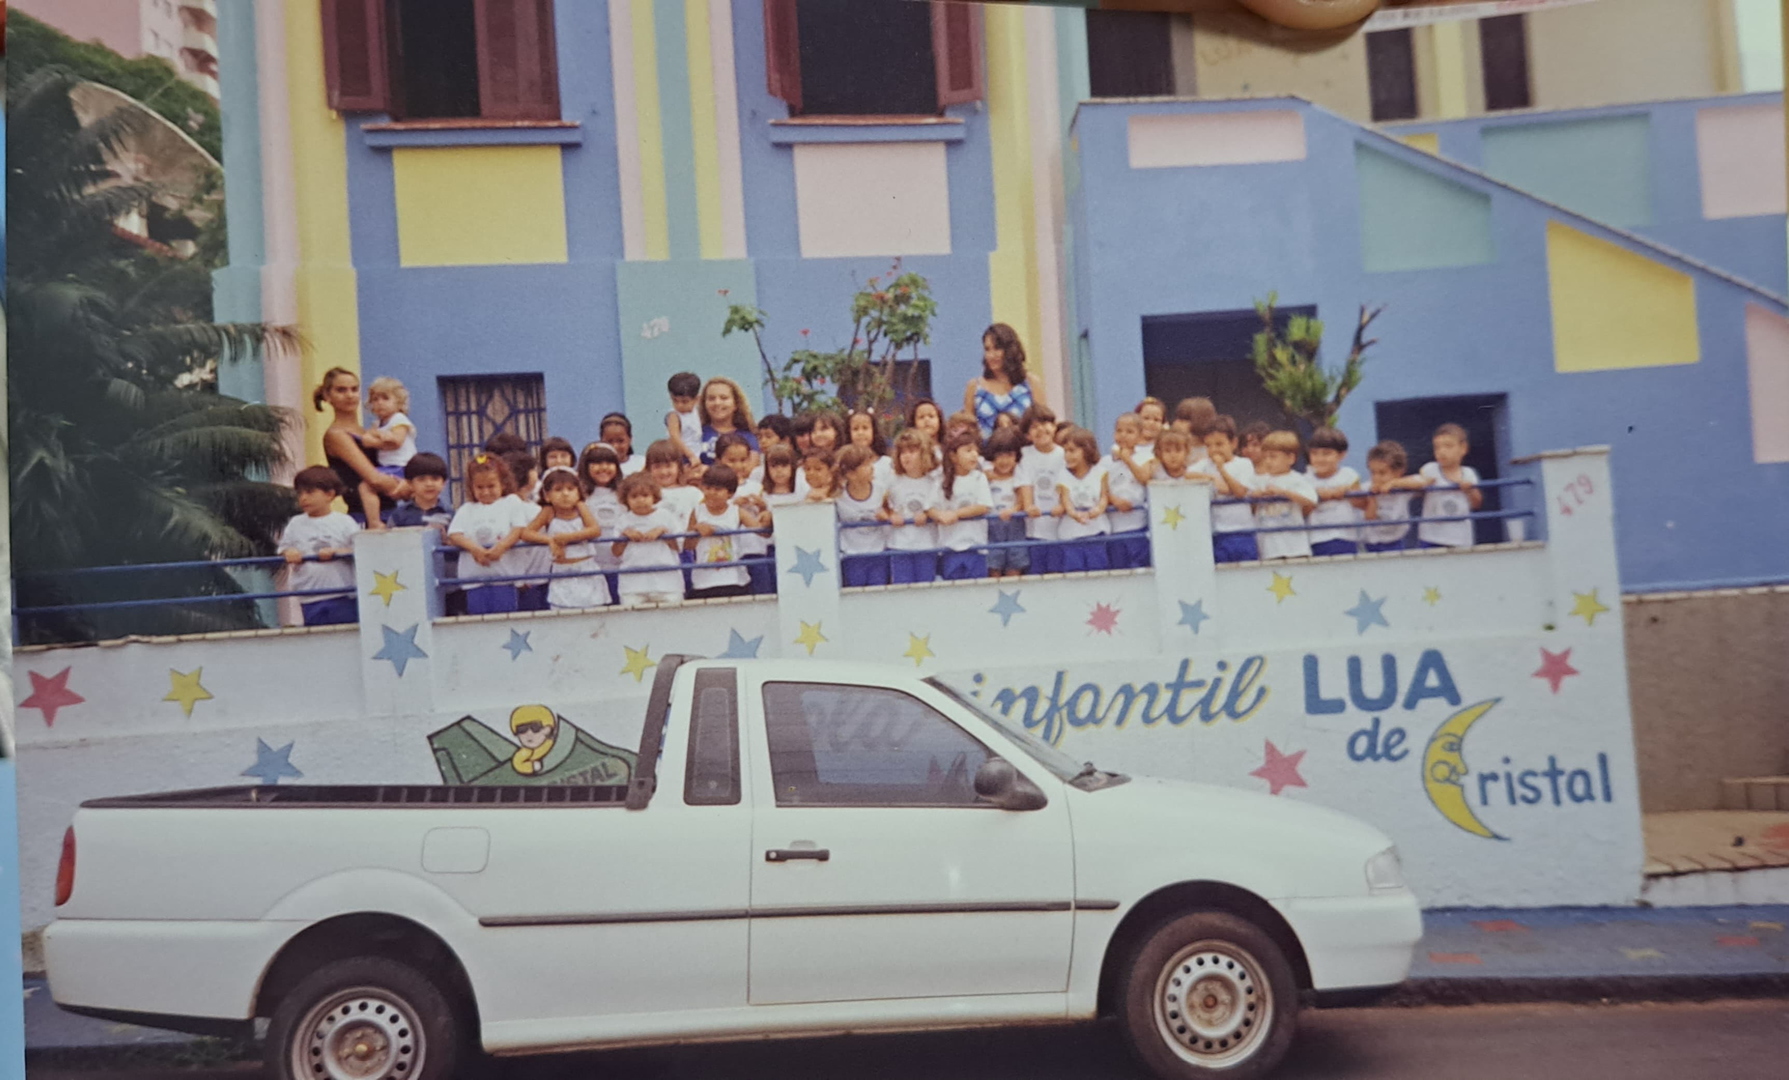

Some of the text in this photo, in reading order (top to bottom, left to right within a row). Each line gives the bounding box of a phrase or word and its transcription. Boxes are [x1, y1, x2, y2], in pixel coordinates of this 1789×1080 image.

[1556, 473, 1595, 518] 479
[1303, 649, 1463, 716] LUA
[1346, 716, 1410, 763] de
